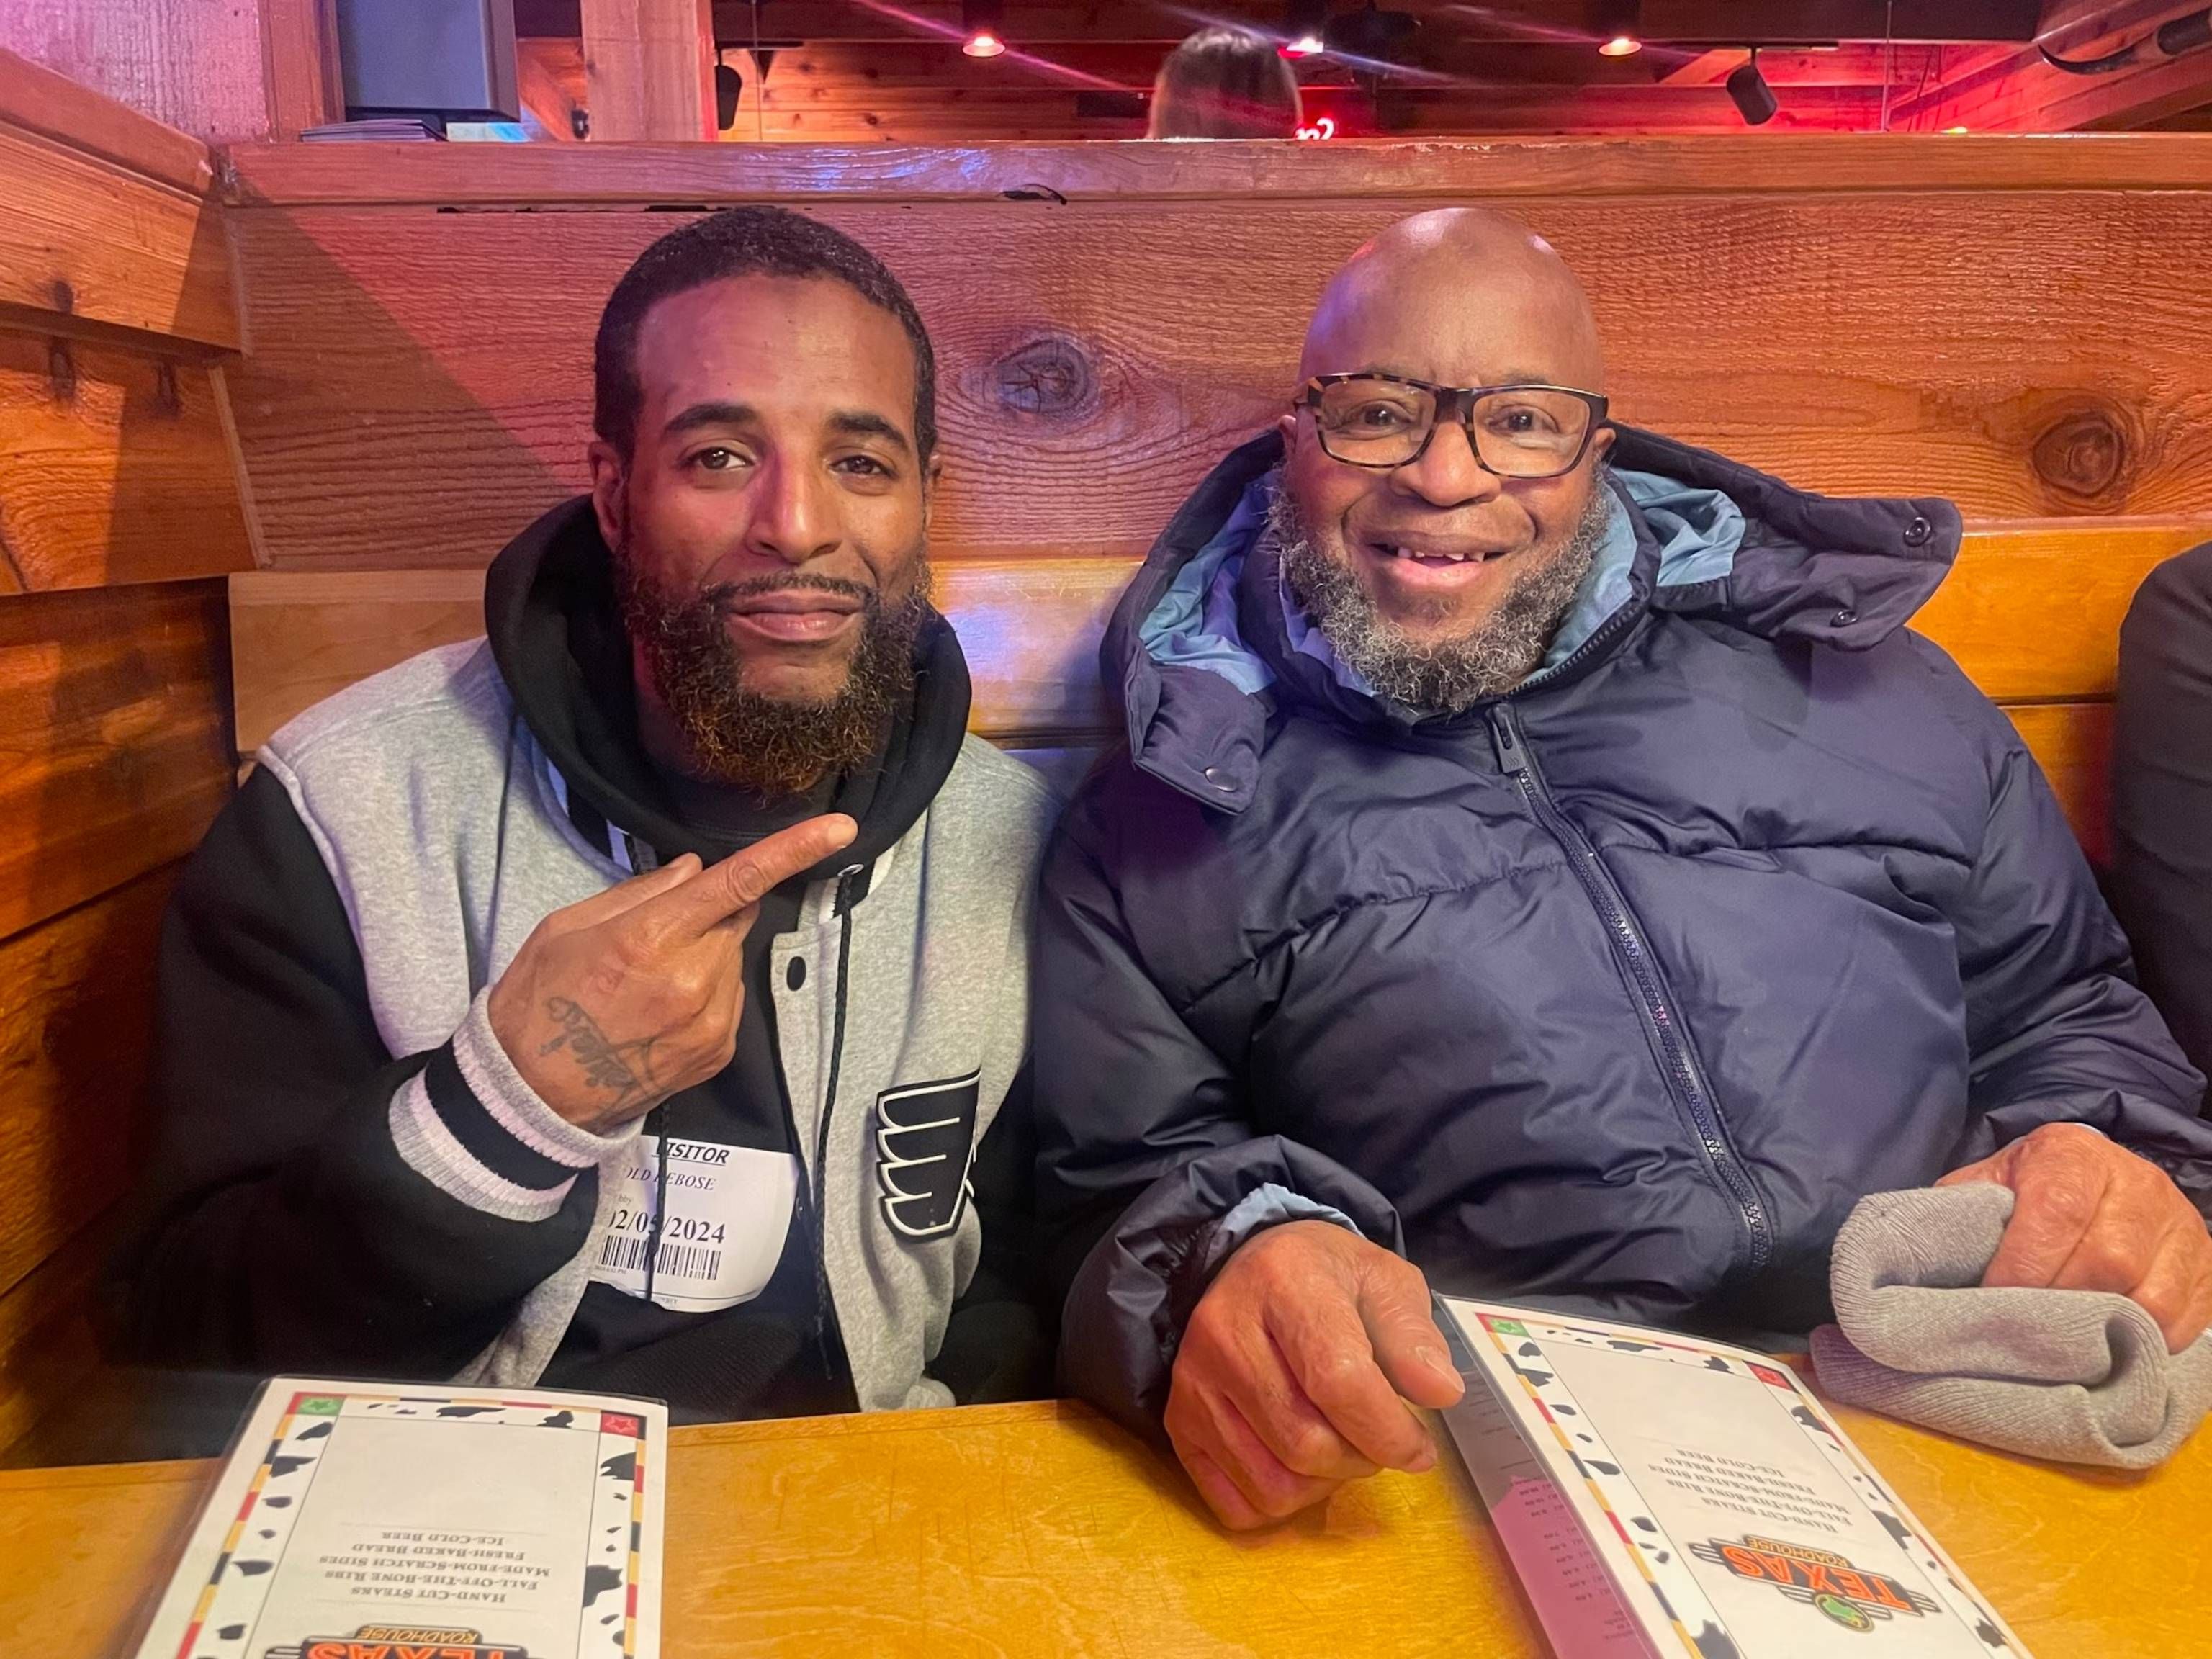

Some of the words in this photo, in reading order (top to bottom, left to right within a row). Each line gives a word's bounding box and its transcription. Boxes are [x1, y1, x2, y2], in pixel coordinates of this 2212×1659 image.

[656, 1141, 729, 1164] ISITOR
[654, 1172, 717, 1190] EBOSE
[1748, 1538, 1849, 1568] ROADHOUSE
[1722, 1546, 1913, 1611] TEXAS
[360, 1627, 478, 1645] ROADHOUSE
